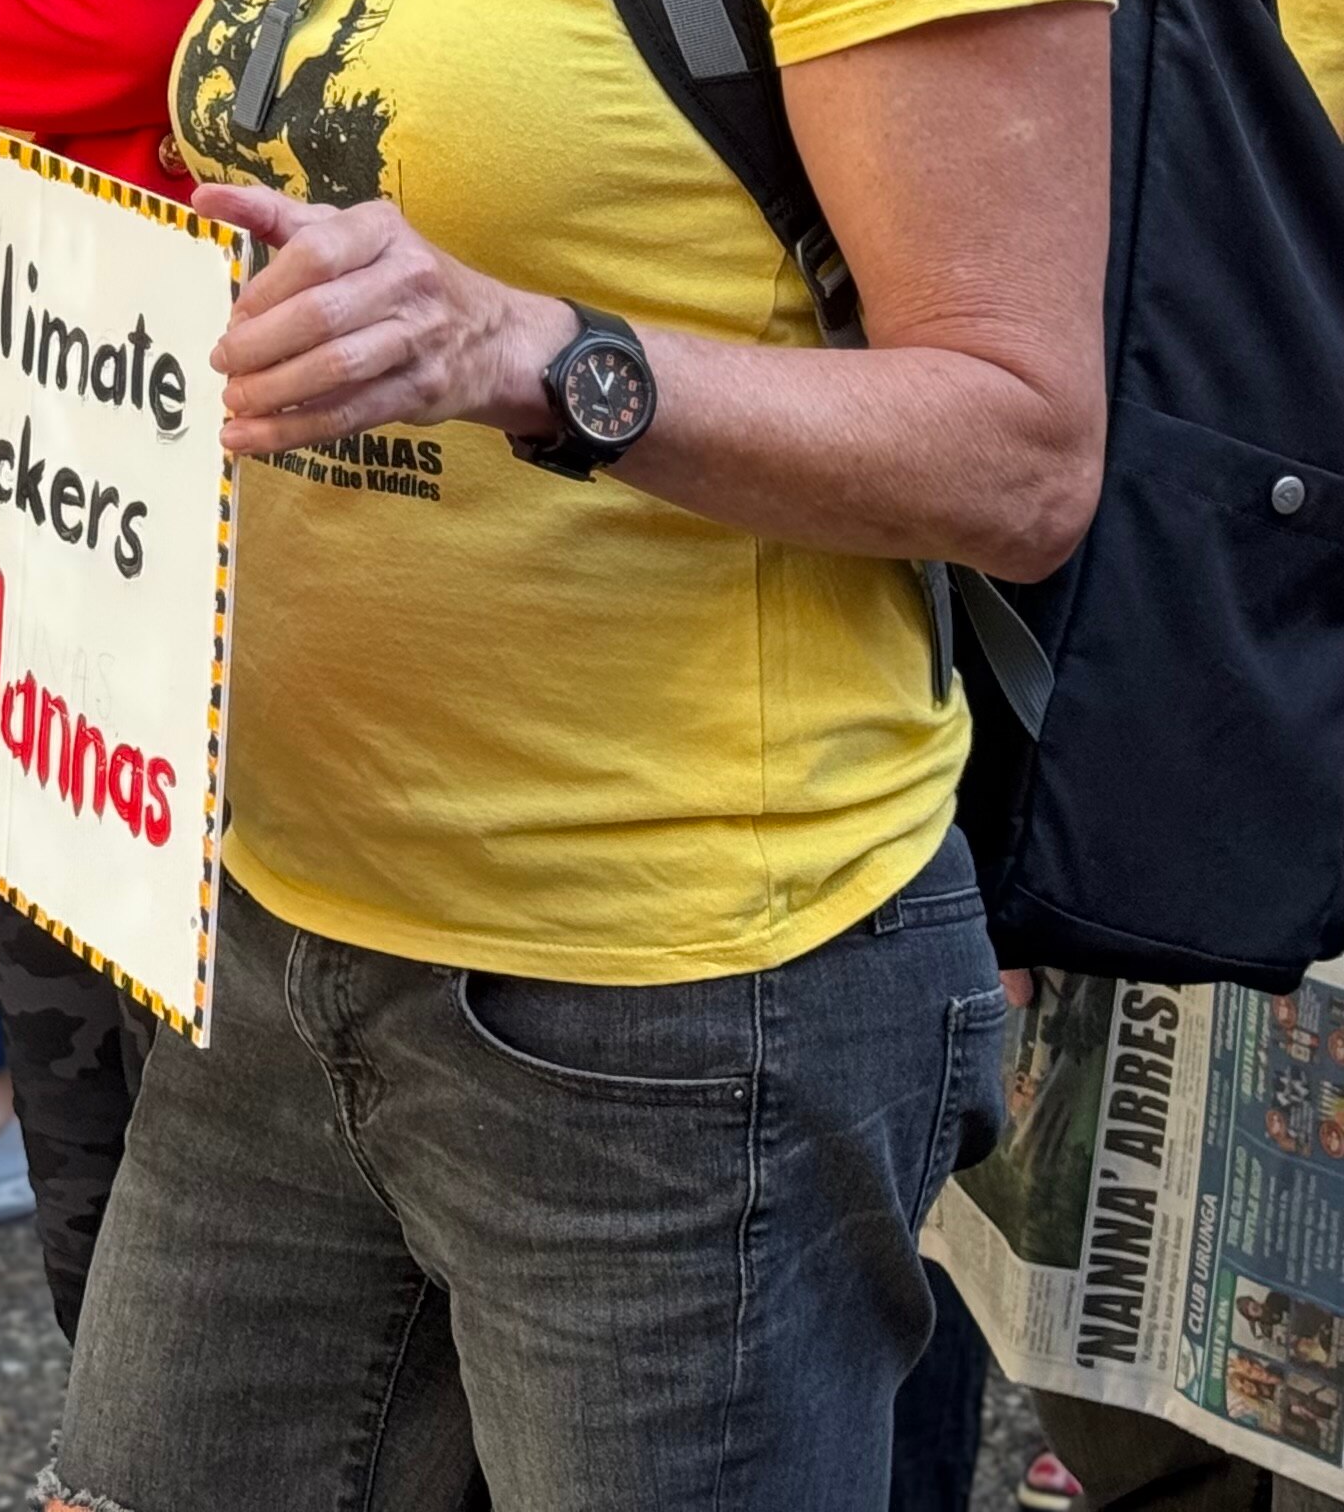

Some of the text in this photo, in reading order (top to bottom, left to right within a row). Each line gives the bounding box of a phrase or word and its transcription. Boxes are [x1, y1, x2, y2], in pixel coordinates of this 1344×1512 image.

[308, 457, 328, 484] for
[332, 464, 362, 489] the
[367, 469, 441, 502] Kiddies
[1104, 978, 1182, 1170] ARRES
[1188, 1193, 1218, 1335] CLUB URUNGA
